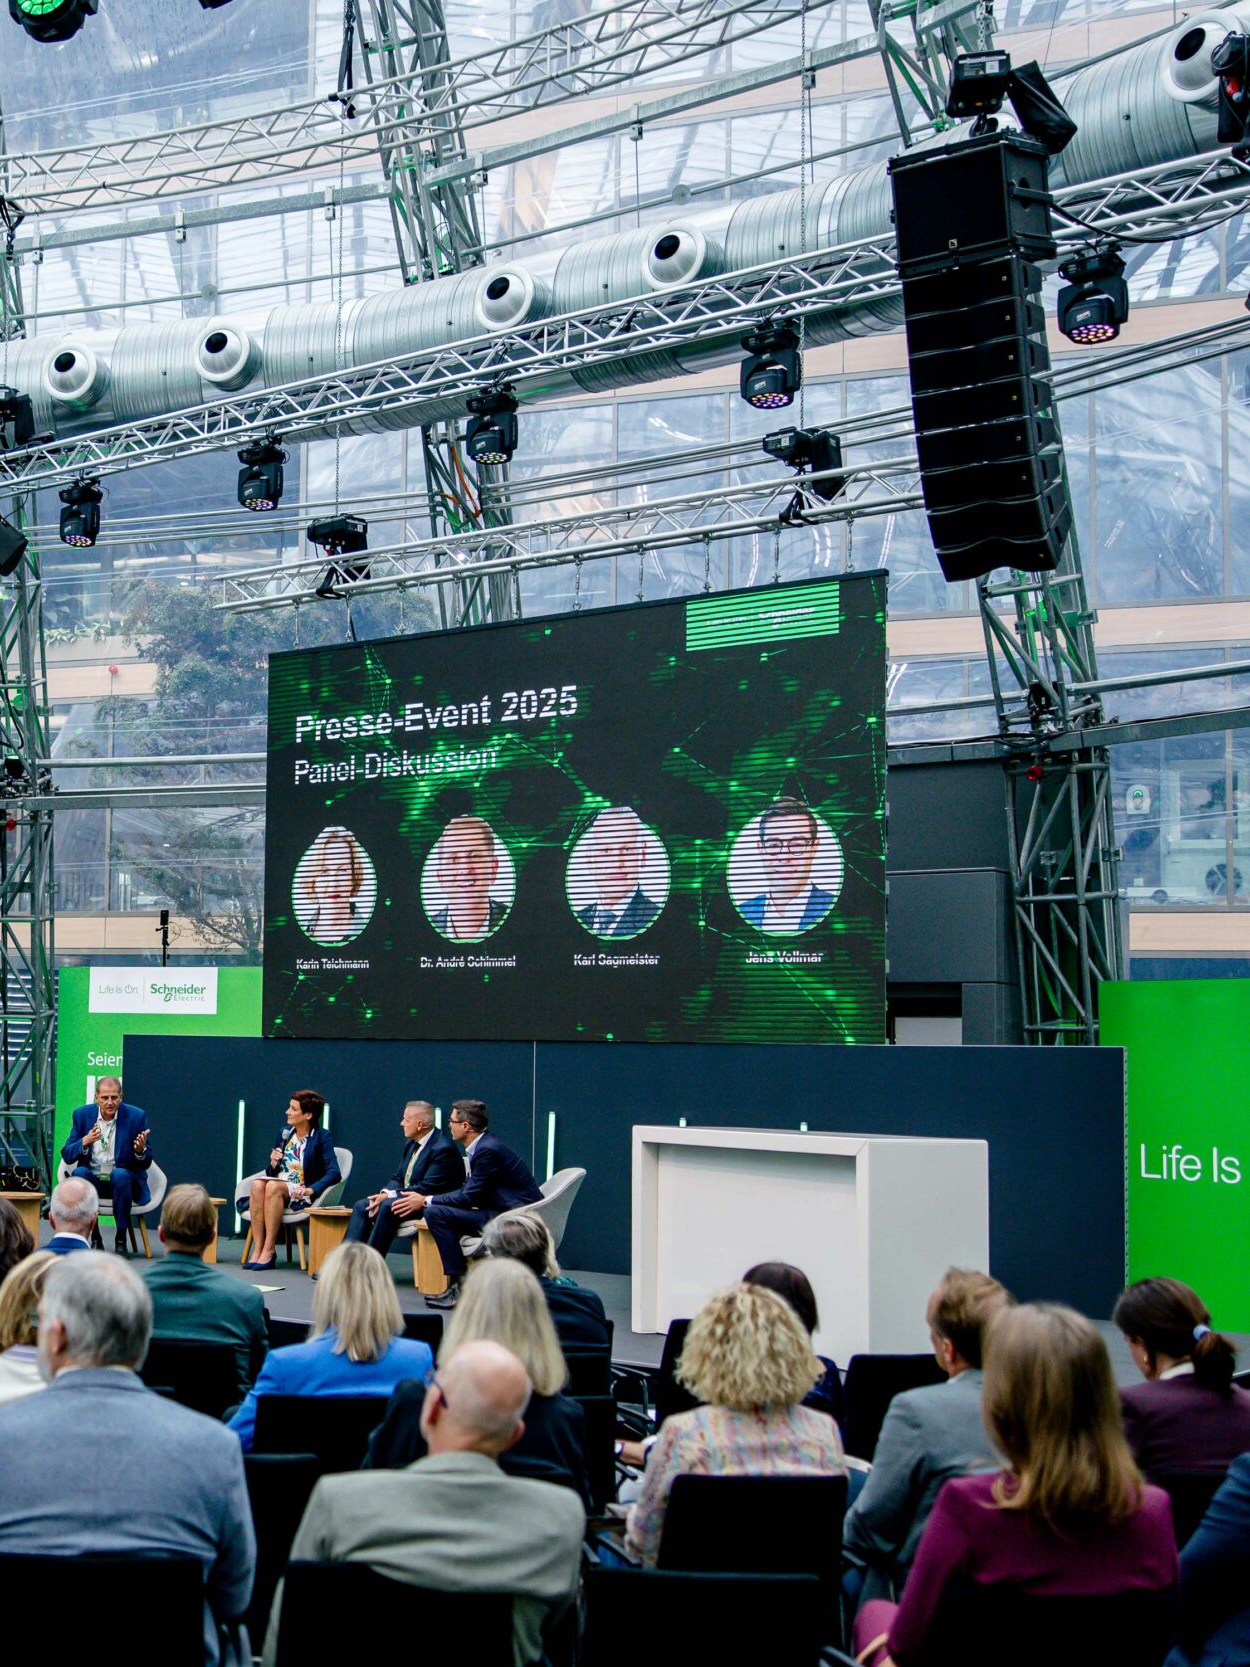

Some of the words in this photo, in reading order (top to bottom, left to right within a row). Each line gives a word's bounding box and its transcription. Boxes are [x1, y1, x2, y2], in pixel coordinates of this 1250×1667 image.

[295, 694, 492, 743] Presse-Event
[500, 684, 579, 722] 2025
[294, 744, 496, 785] Panel-Diskussion
[296, 958, 319, 969] Karin
[321, 957, 370, 969] Teichmann
[420, 956, 433, 968] Dr.
[435, 955, 465, 968] André
[467, 955, 516, 967] Schimmel
[573, 954, 595, 966] Karl
[597, 953, 660, 969] Sagmeister
[776, 951, 824, 963] Vollmar
[98, 984, 114, 994] Life
[115, 984, 123, 994] Is
[124, 984, 139, 994] On
[150, 983, 206, 995] Schneider
[173, 994, 206, 1002] Electric
[1140, 1143, 1202, 1182] Life
[1212, 1146, 1242, 1184] Is
